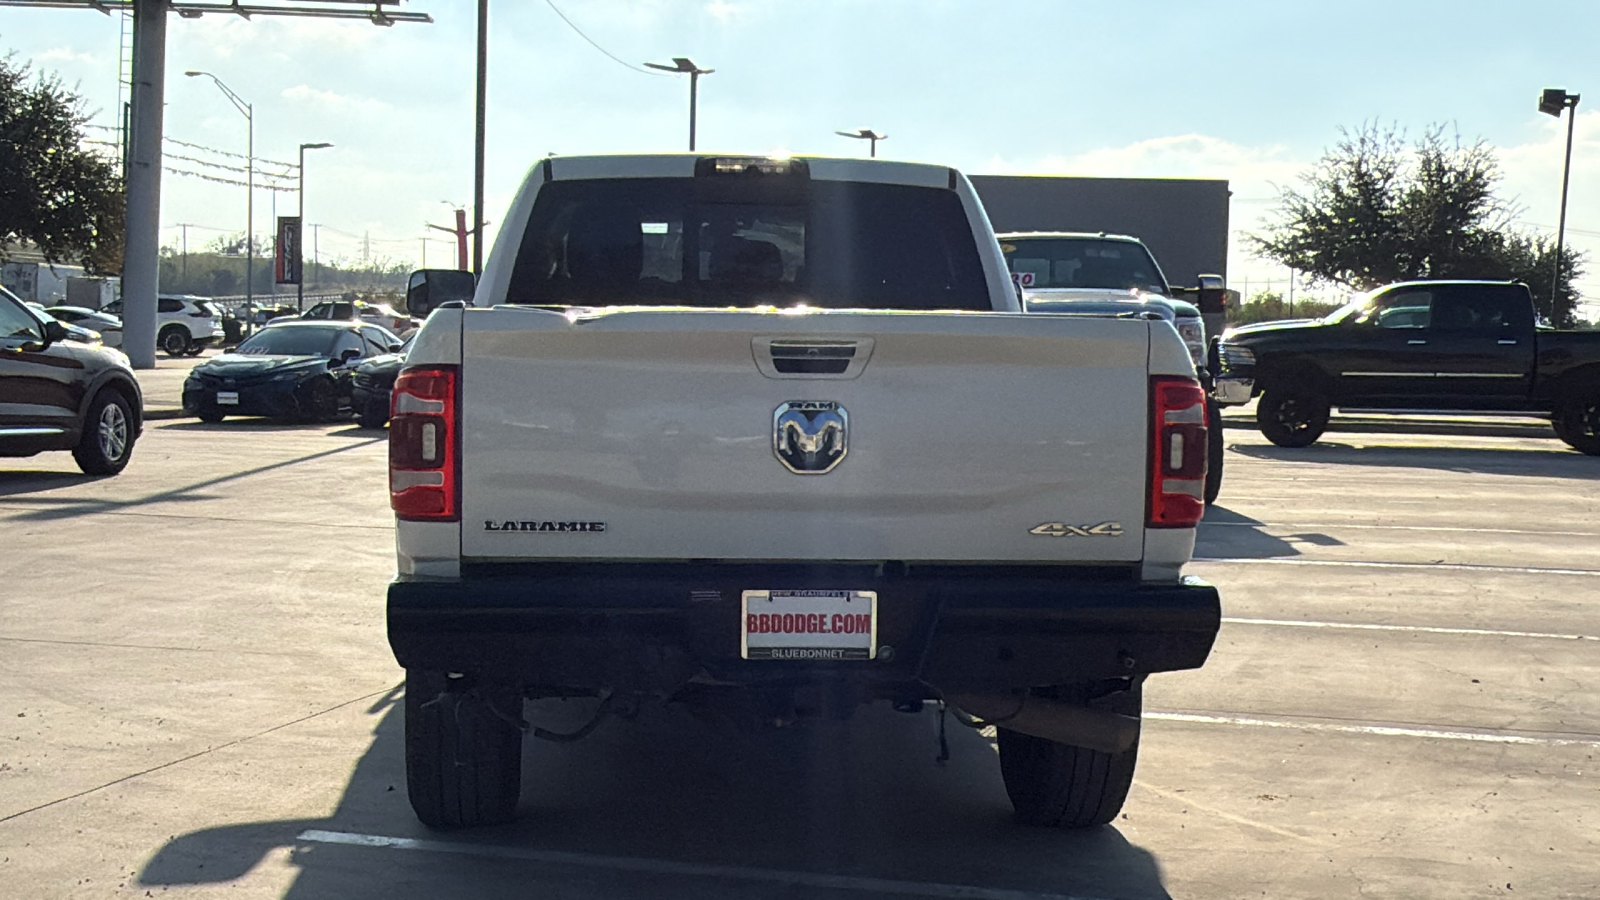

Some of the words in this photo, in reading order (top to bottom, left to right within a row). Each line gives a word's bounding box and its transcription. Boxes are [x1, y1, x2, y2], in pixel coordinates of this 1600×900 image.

[786, 401, 836, 411] RAM
[484, 520, 605, 532] LARAMIE
[747, 613, 870, 633] BBDODGE.COM
[771, 649, 845, 659] BLUEBONNET
